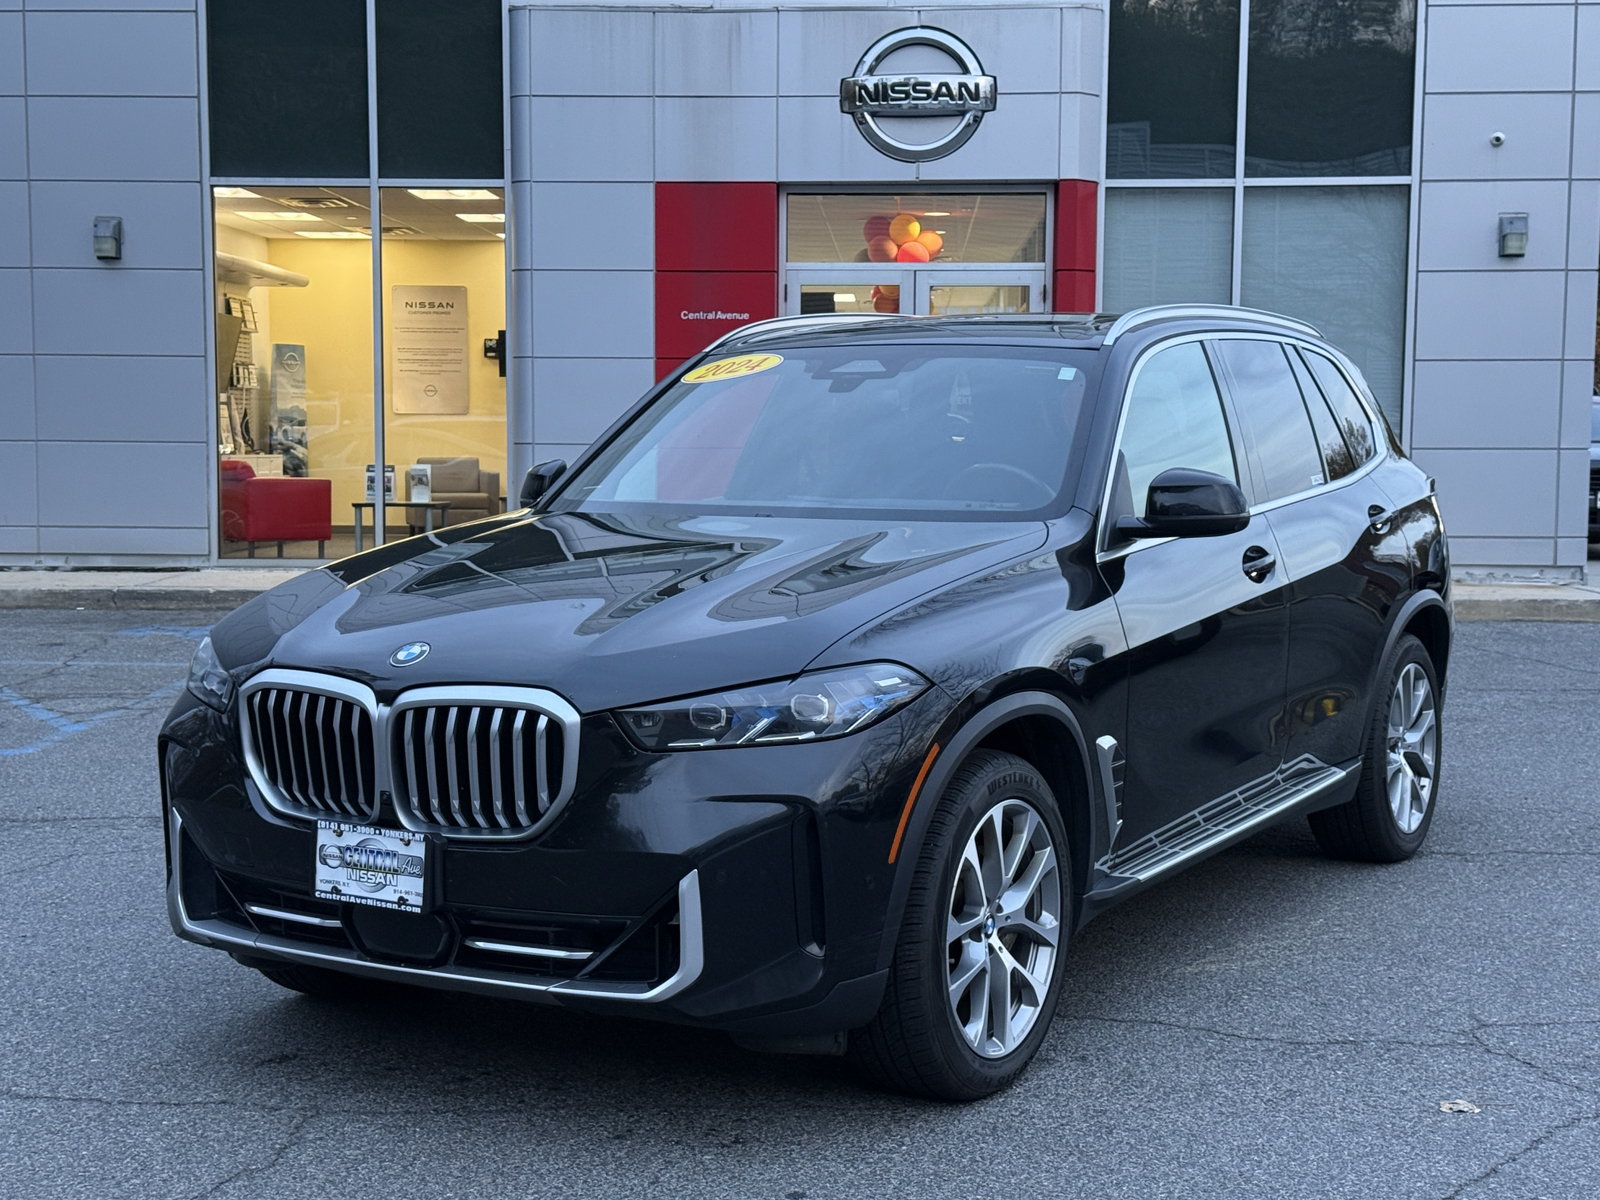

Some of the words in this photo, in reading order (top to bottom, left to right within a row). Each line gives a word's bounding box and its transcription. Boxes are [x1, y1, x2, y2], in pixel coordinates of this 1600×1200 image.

[856, 81, 981, 105] NISSAN
[405, 301, 454, 309] NISSAN
[680, 310, 715, 320] Central
[716, 310, 750, 320] Avenue
[694, 356, 771, 380] 2024
[986, 772, 1035, 796] WESTLAKE
[317, 820, 338, 829] (914)
[322, 852, 343, 860] NISSAN
[343, 845, 401, 874] CENTRAL
[401, 857, 422, 875] Ave.
[347, 868, 398, 887] NISSAN
[314, 891, 422, 914] CentralAveNissan.com
